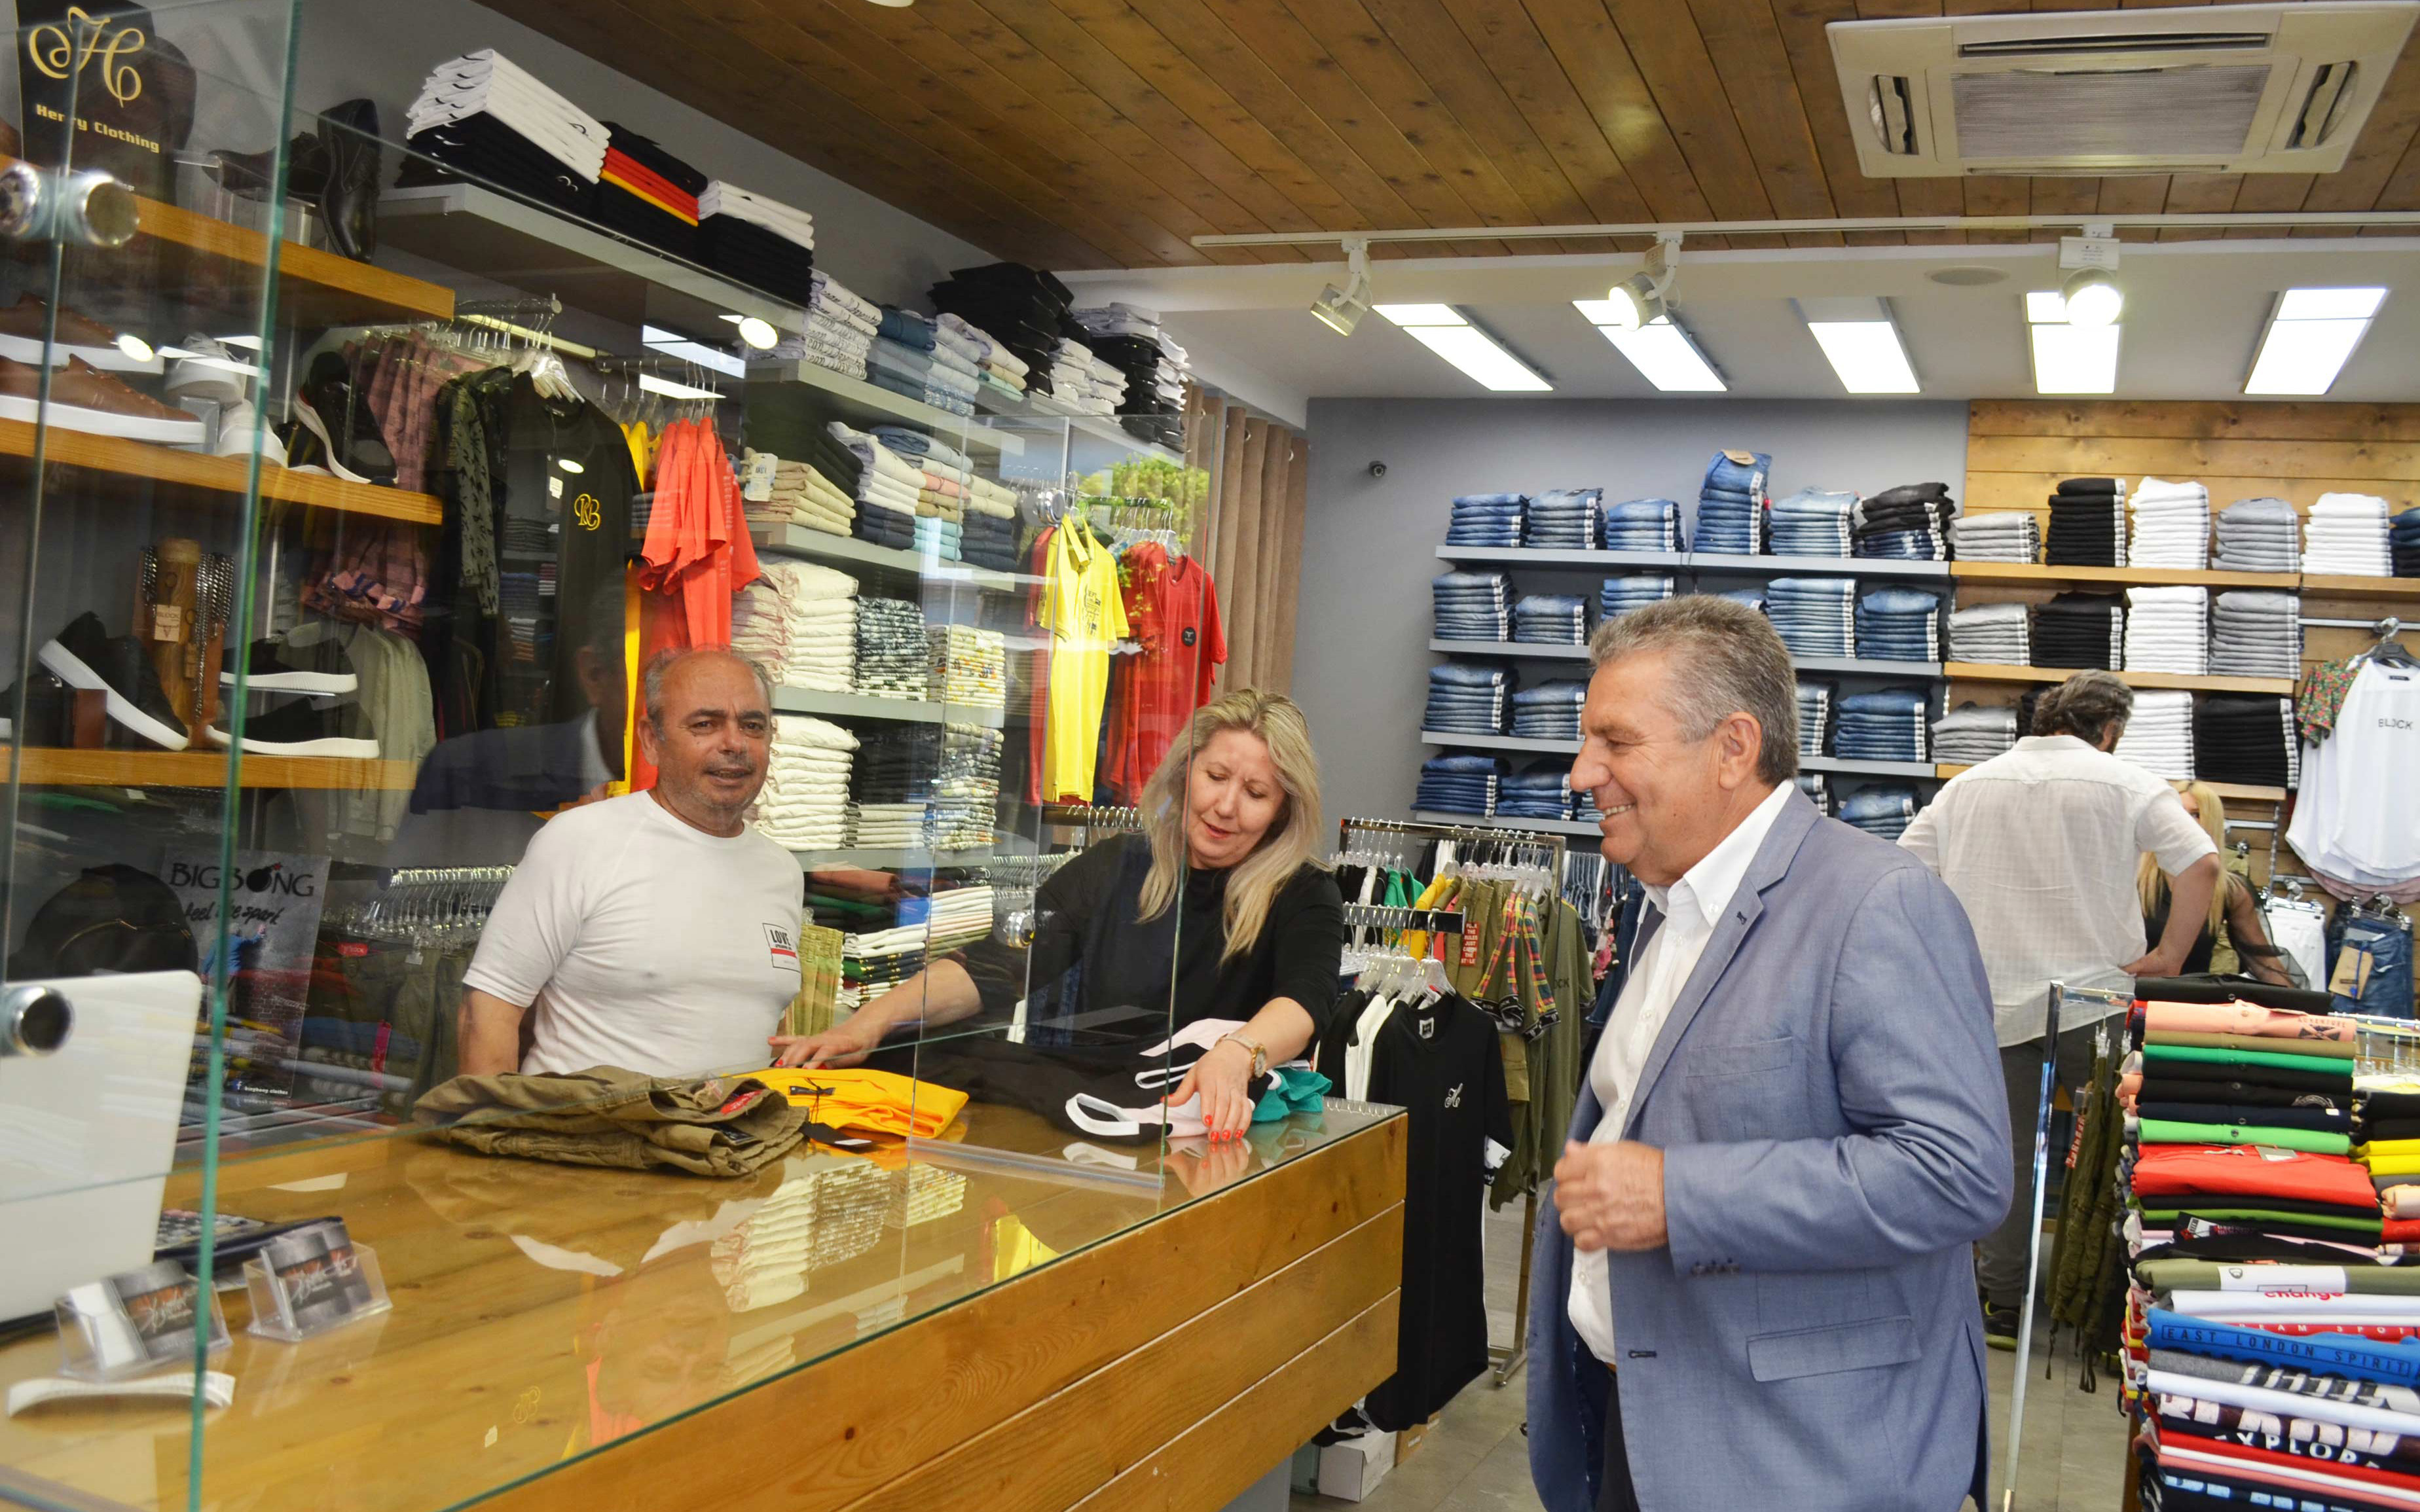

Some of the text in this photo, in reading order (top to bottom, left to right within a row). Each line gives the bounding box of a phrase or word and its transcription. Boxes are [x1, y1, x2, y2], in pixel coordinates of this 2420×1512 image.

[94, 122, 160, 153] Clothing
[2168, 1328, 2216, 1342] EAST
[2236, 1333, 2315, 1356] LONDON
[2334, 1350, 2406, 1373] SPIRIT
